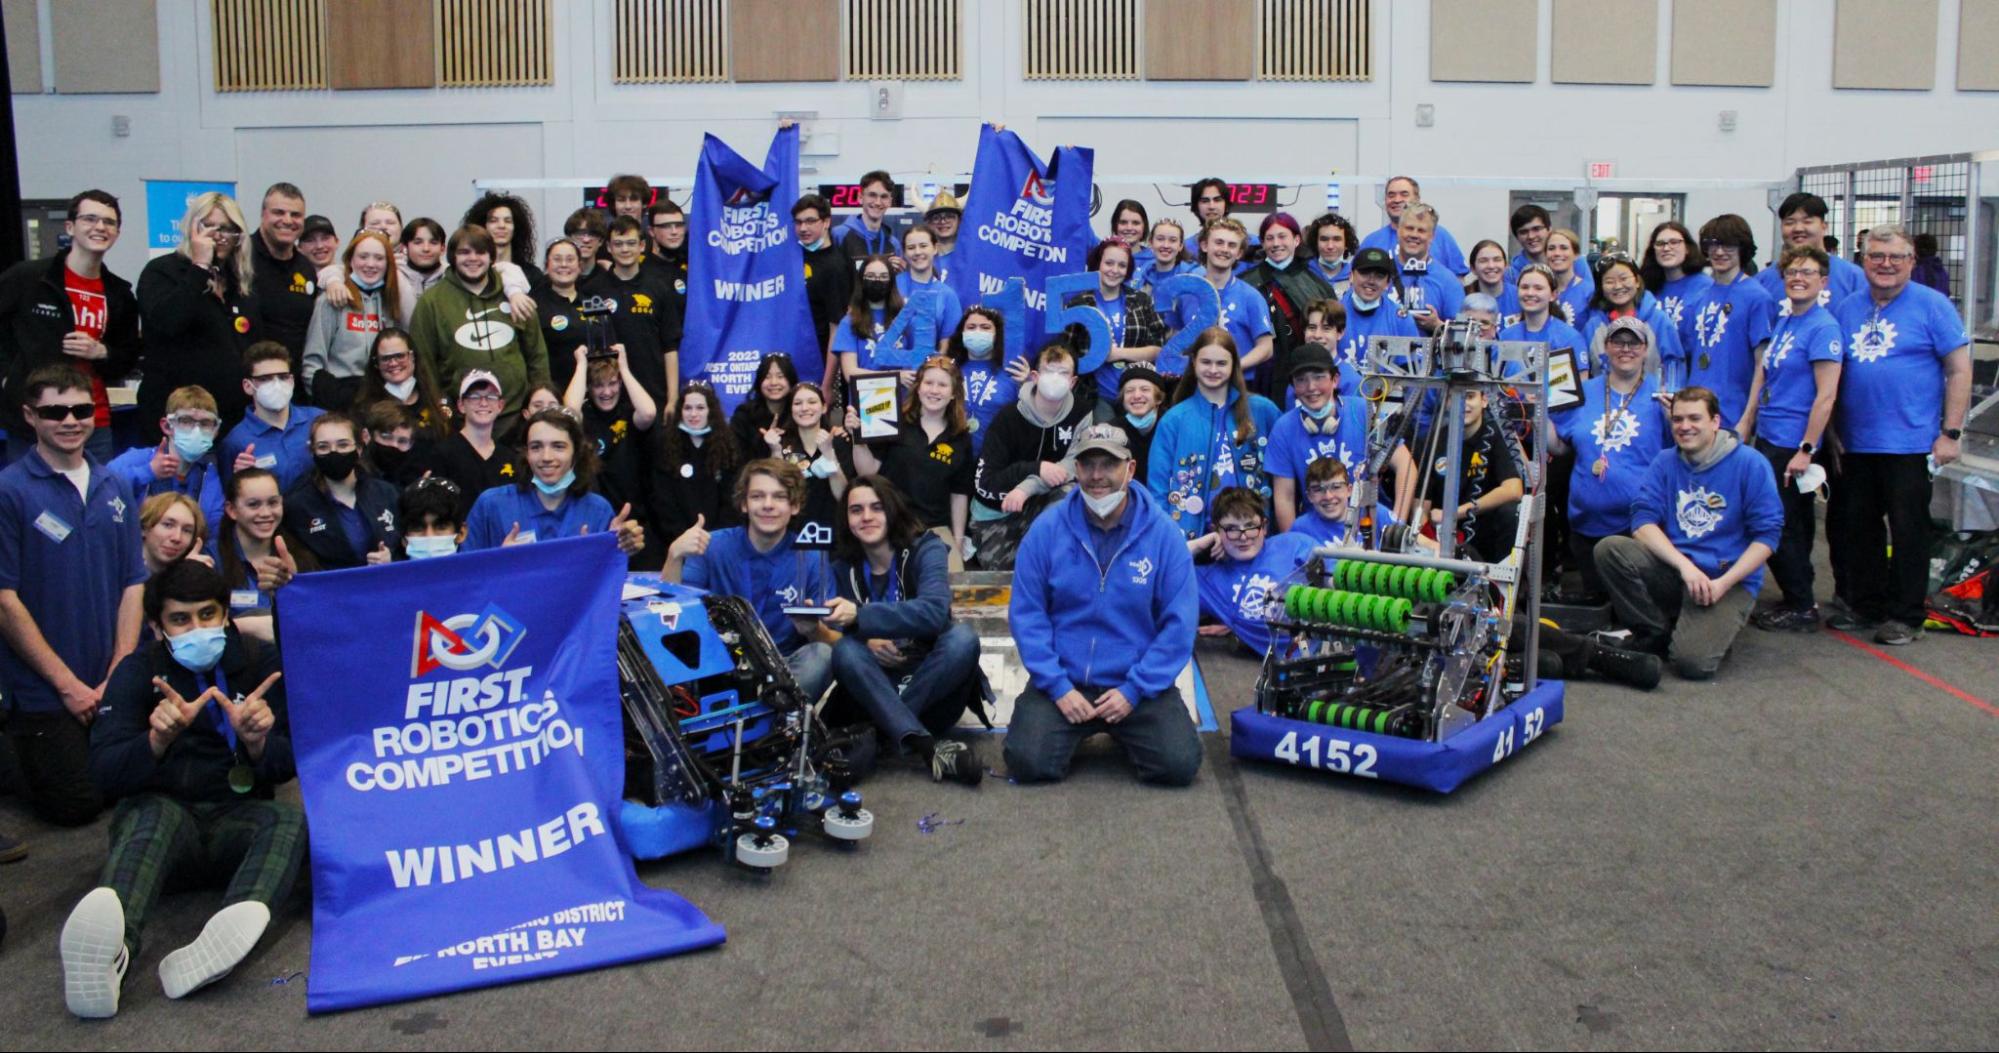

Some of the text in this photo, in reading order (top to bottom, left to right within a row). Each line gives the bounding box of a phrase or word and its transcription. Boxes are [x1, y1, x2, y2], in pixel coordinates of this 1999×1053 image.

[1010, 199, 1053, 227] FIRS
[727, 350, 760, 361] 2023
[711, 373, 752, 383] NORTH
[405, 665, 533, 720] FIRST
[372, 690, 560, 758] ROBOTICS
[1492, 706, 1545, 764] 41 52
[1273, 731, 1379, 779] 4152
[384, 801, 606, 889] WINNER
[553, 900, 626, 924] DISTRICT
[536, 927, 587, 950] BAY
